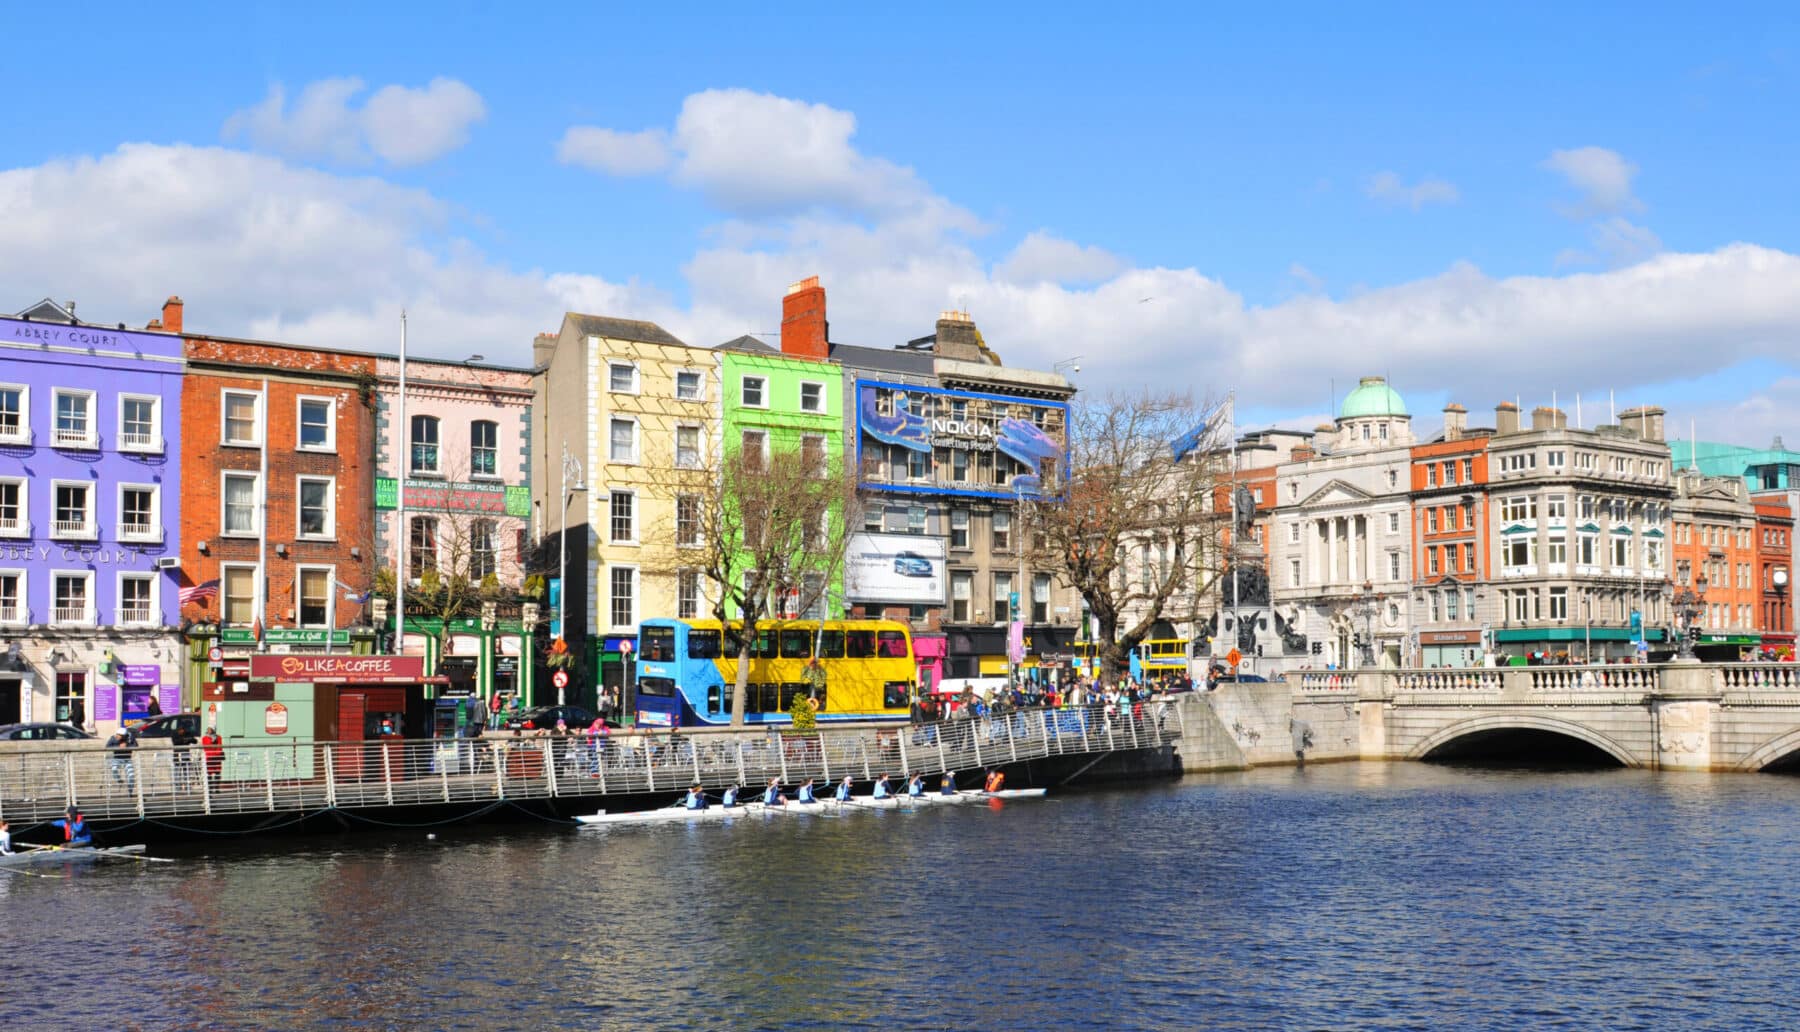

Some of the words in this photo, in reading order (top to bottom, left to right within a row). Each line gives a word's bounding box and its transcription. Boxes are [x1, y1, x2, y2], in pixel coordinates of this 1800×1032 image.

[15, 327, 60, 340] ABBEY
[69, 332, 120, 345] COURT
[932, 420, 992, 437] NOKIA
[931, 437, 969, 451] Connecting
[970, 440, 993, 452] People
[63, 548, 137, 564] COURT
